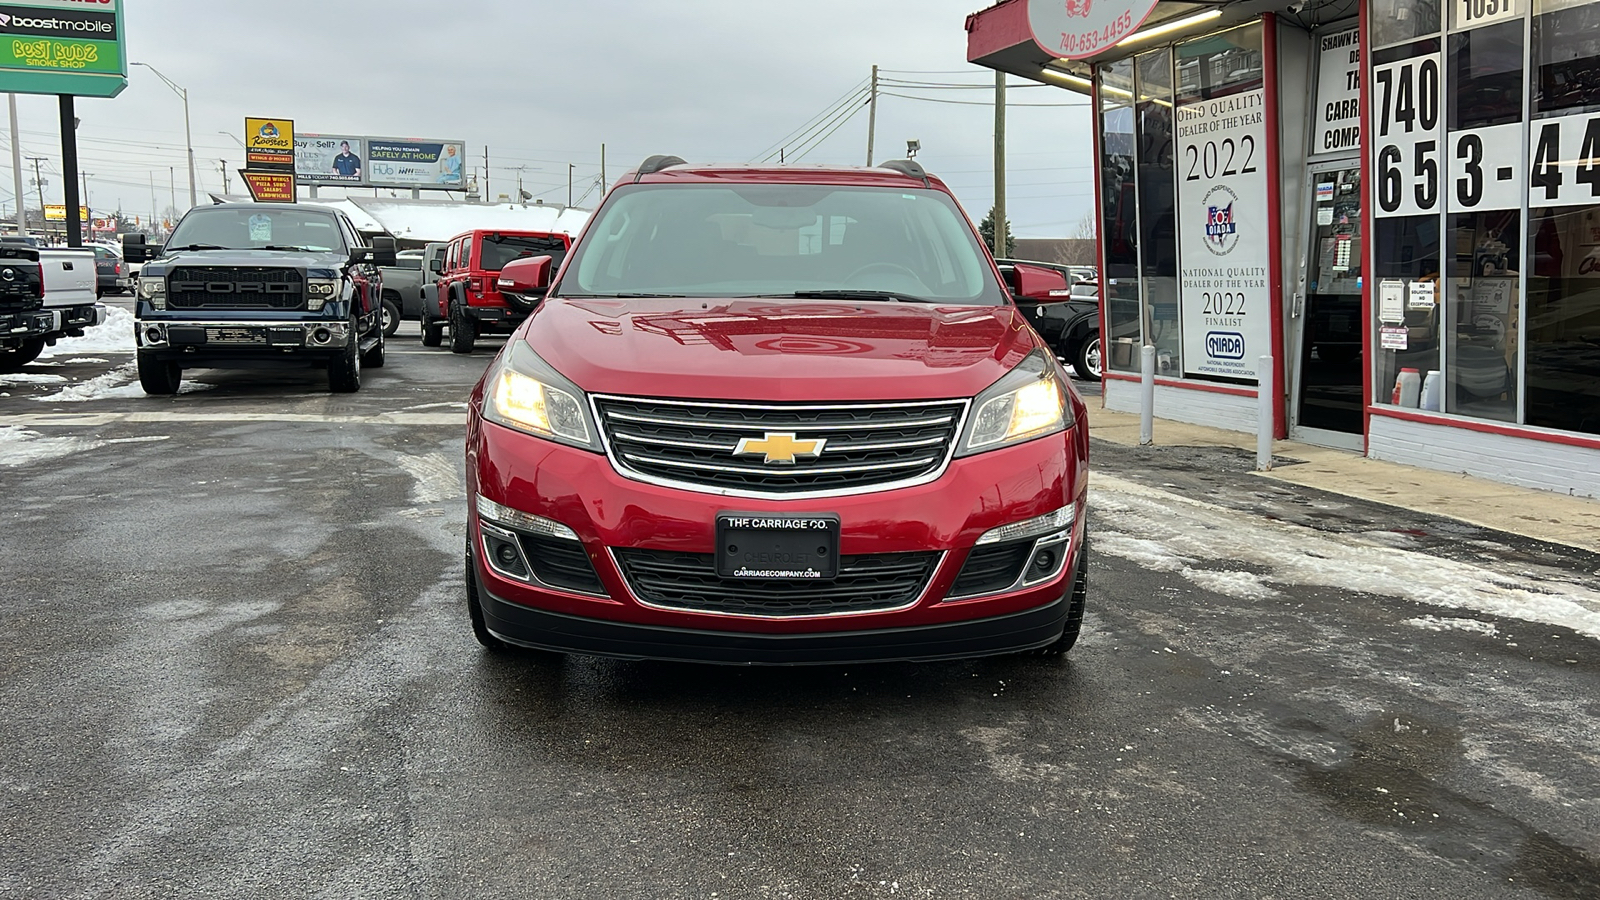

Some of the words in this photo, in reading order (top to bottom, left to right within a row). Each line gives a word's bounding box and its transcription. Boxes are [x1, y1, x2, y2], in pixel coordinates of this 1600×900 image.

[12, 15, 113, 33] boostmobile
[1060, 9, 1132, 52] 740-653-4455
[1322, 31, 1351, 51] SHAWN
[26, 58, 58, 67] SMOKE
[60, 60, 85, 68] SHOP
[1377, 59, 1438, 137] 740
[1177, 105, 1206, 122] OHIO
[1210, 93, 1263, 117] QUALITY
[1179, 122, 1208, 138] DEALER
[1209, 119, 1220, 132] OF
[1221, 116, 1239, 130] THE
[1239, 111, 1262, 126] YEAR
[252, 136, 289, 147] Roosters
[1324, 126, 1361, 150] COMP
[371, 151, 400, 159] SAFELY
[1186, 134, 1257, 181] 2022
[1209, 224, 1231, 235] OIADA
[1183, 268, 1224, 277] NATIONAL
[1227, 267, 1266, 278] QUALITY
[170, 281, 302, 294] FORD
[1184, 280, 1211, 288] DEALER
[1214, 280, 1223, 288] OF
[1226, 280, 1242, 288] THE
[1244, 279, 1265, 288] YEAR
[1202, 292, 1246, 315] 2022
[1205, 318, 1242, 326] FINALIST
[1209, 338, 1241, 354] NIADA
[728, 518, 749, 528] THE
[751, 519, 807, 529] CARRIAGE
[810, 520, 828, 529] CO.
[744, 552, 812, 564] CHEVROLET
